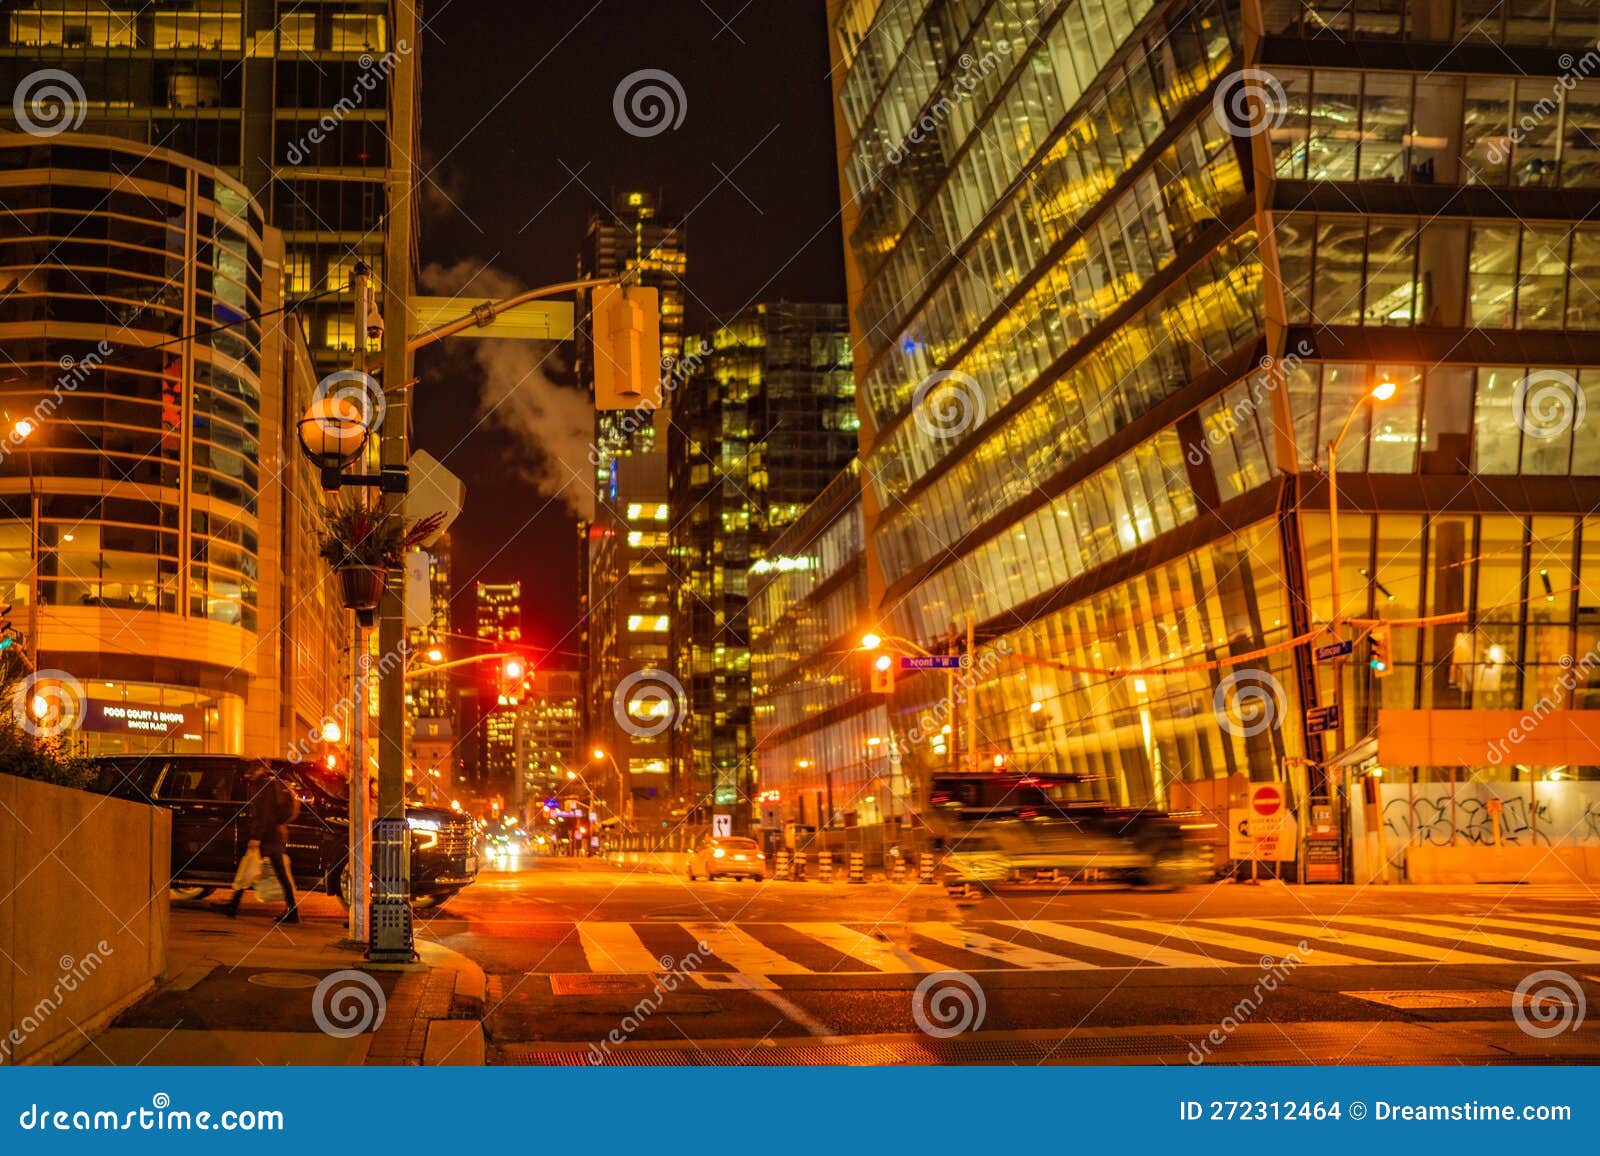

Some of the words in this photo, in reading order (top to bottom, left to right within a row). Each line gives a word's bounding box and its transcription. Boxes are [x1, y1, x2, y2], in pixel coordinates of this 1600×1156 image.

[103, 706, 126, 718] FOOD
[126, 708, 152, 721] COURT
[159, 712, 184, 724] SHOPS
[149, 722, 168, 732] PLACE
